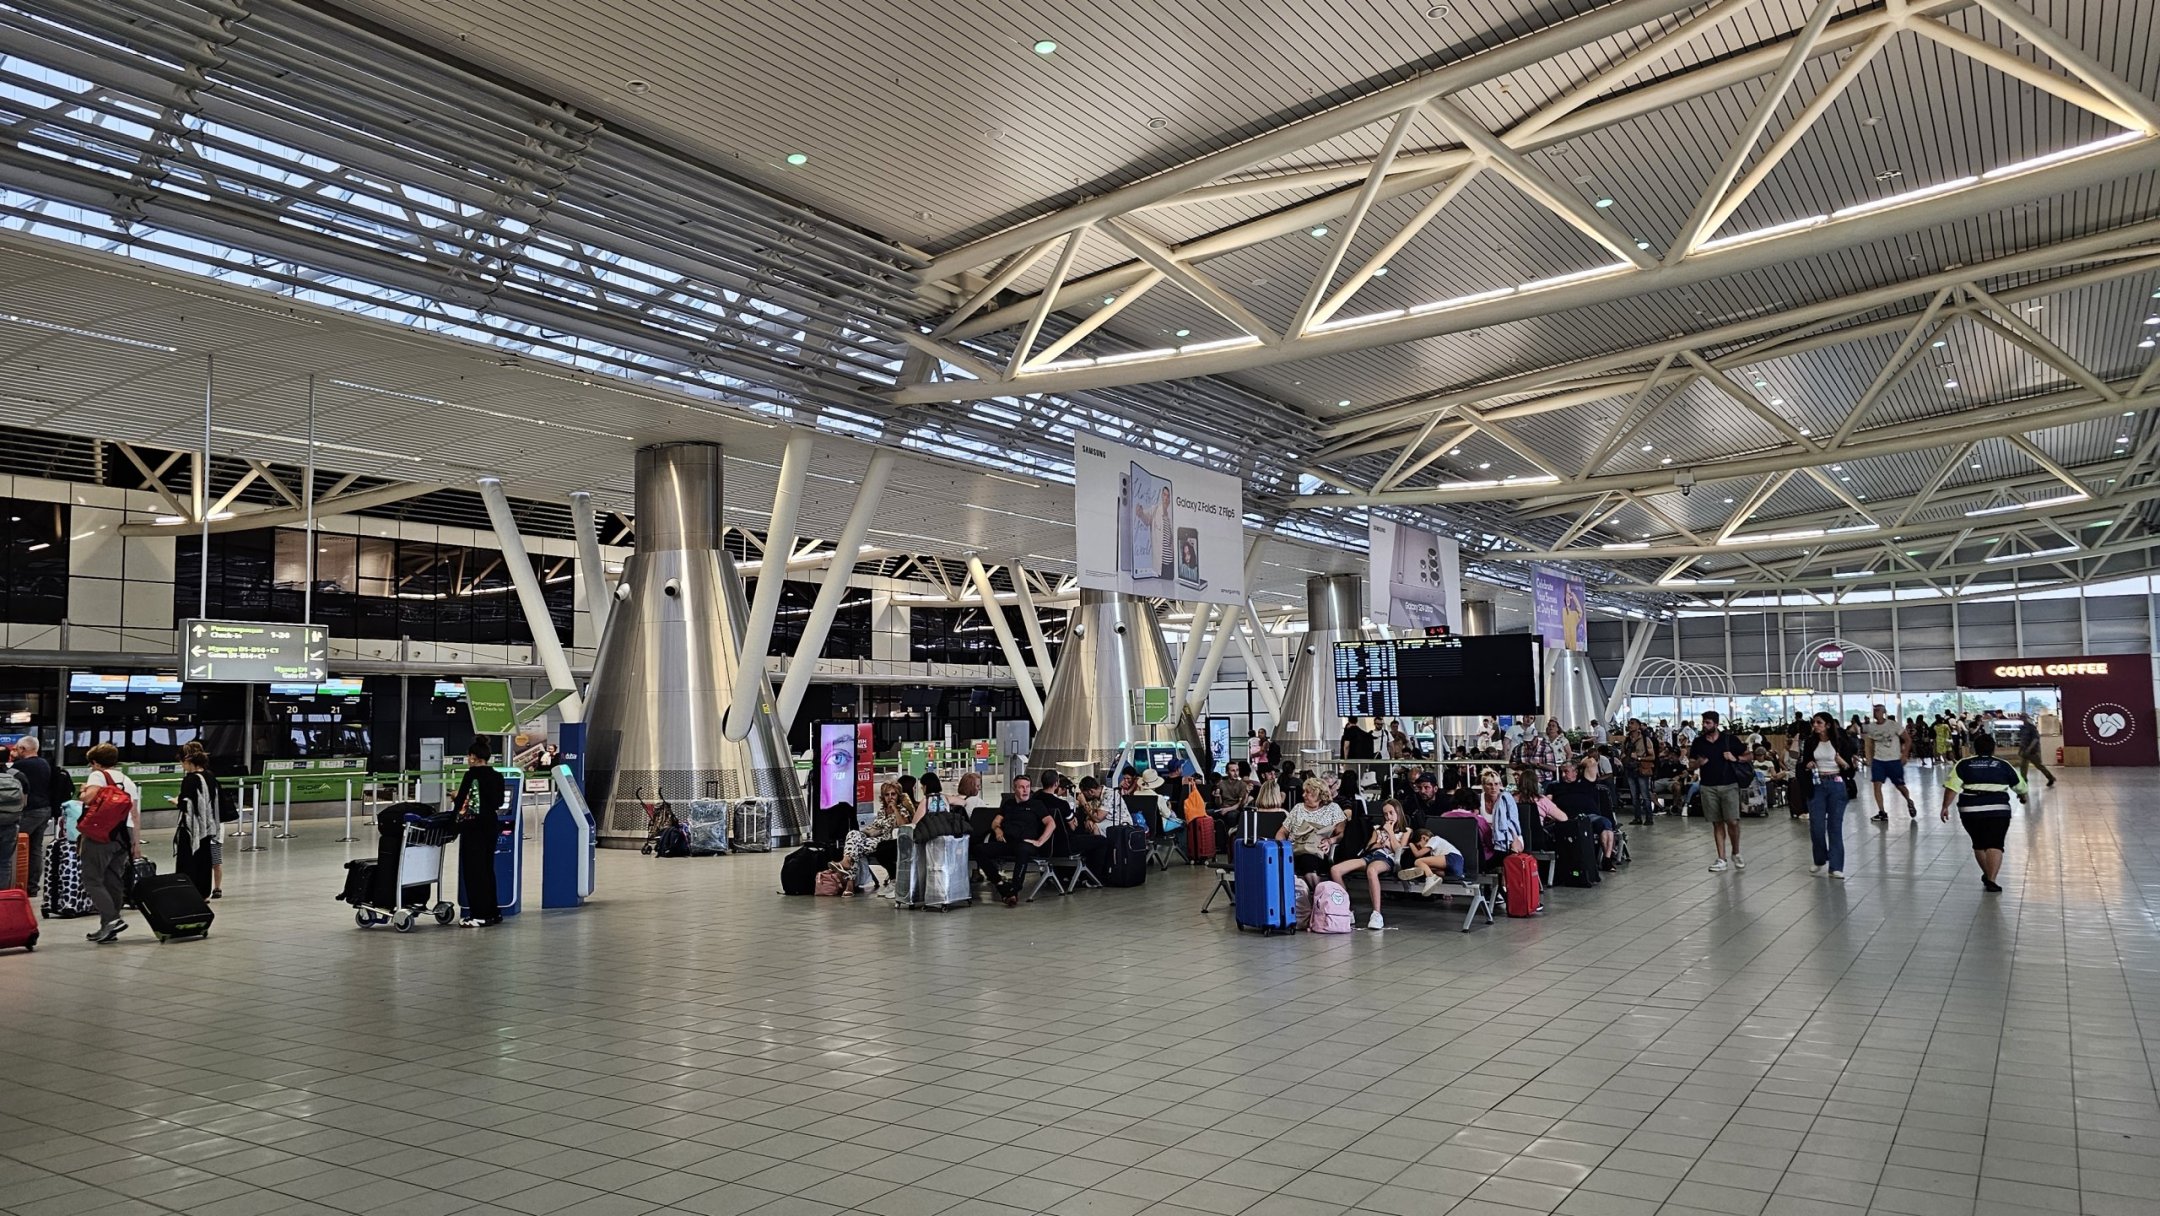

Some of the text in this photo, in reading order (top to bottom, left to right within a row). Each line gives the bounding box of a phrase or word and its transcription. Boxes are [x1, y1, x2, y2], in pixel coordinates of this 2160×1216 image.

[1082, 445, 1106, 459] SAMSUNG
[1176, 496, 1235, 520] Galaxy Z Fold5 Z Flip5
[1536, 577, 1554, 591] Celebrate
[1536, 590, 1546, 601] Your
[1994, 662, 2108, 678] COSTA COFFEE
[91, 705, 104, 714] 18
[146, 705, 158, 714] 19
[286, 706, 299, 714] 20
[330, 706, 340, 714] 21
[446, 706, 456, 714] 22
